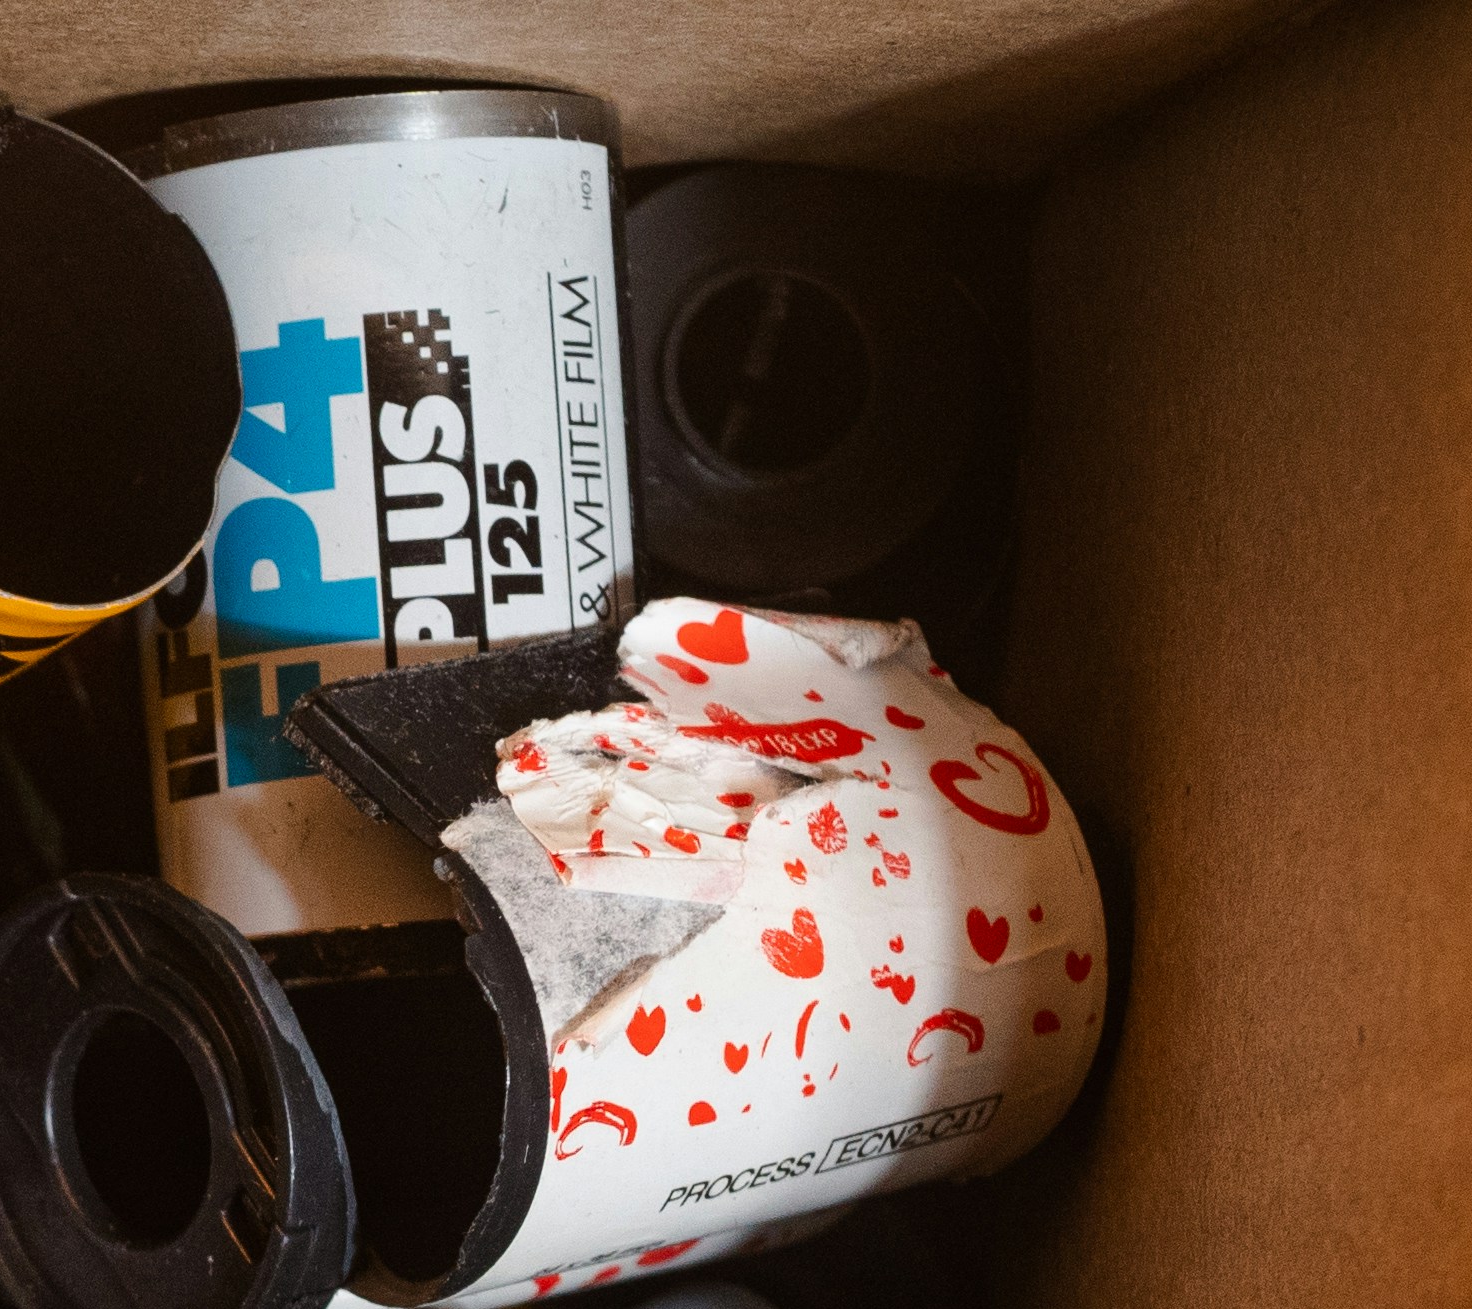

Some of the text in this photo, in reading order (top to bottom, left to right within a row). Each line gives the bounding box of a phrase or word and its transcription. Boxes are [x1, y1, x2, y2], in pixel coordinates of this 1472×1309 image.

[557, 275, 596, 385] FILM
[381, 393, 476, 658] PLUS
[484, 459, 544, 605] 125
[567, 401, 607, 572] WHITE
[660, 1152, 817, 1212] PROCESS
